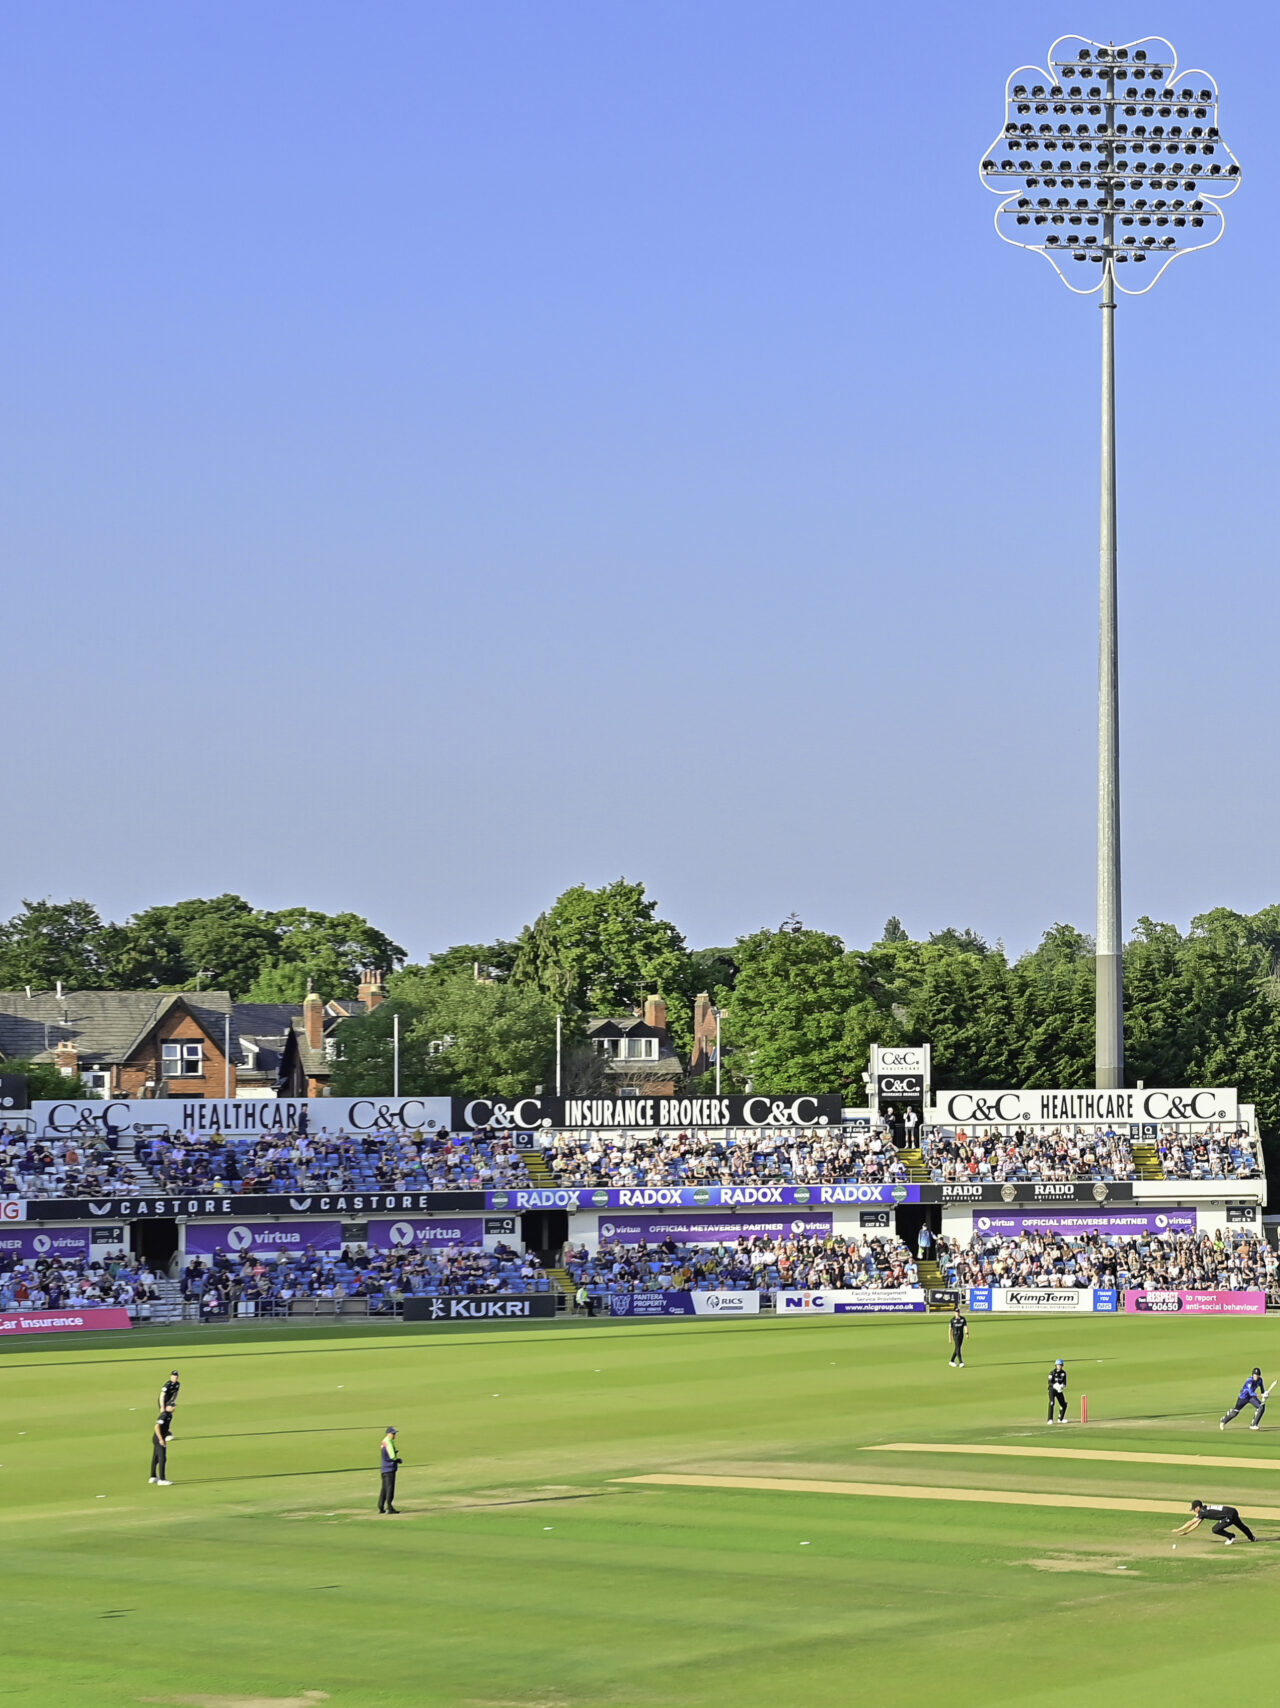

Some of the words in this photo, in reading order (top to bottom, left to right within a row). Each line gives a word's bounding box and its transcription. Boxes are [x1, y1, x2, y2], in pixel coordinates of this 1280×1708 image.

[1041, 1094, 1134, 1119] HEALTHCARE
[564, 1099, 654, 1127] INSURANCE
[659, 1098, 731, 1126] BROKERS
[1144, 1126, 1153, 1135] Q
[820, 1186, 883, 1203] RADOX
[942, 1185, 982, 1196] RADO
[1034, 1184, 1075, 1195] RADO
[516, 1190, 580, 1209] RADOX
[619, 1189, 683, 1206] RADOX
[720, 1187, 783, 1205] RADOX
[120, 1200, 232, 1214] CASTORE
[320, 1196, 428, 1210] CASTORE
[878, 1214, 887, 1222] Q
[1244, 1209, 1253, 1218] Q
[503, 1220, 512, 1229] Q
[991, 1219, 1015, 1227] virtua
[1022, 1219, 1059, 1227] OFFICIAL
[1060, 1218, 1108, 1226] METAVERSE
[1109, 1217, 1148, 1225] PARTNER
[1168, 1217, 1192, 1225] virtua
[615, 1224, 641, 1233] virtua
[648, 1224, 689, 1233] OFFICIAL
[690, 1223, 742, 1233] METAVERSE
[743, 1223, 784, 1231] PARTNER
[805, 1222, 831, 1231] virtua
[113, 1229, 120, 1238] P
[254, 1230, 301, 1243] virtua
[416, 1227, 461, 1240] virtua
[52, 1238, 85, 1248] virtua
[1009, 1292, 1075, 1305] KrimpTerm
[1146, 1291, 1179, 1303] RESPECT
[1194, 1295, 1217, 1303] report
[450, 1299, 530, 1317] KUKRI
[844, 1303, 914, 1312] www.nicgroup.co.uk
[1151, 1302, 1178, 1311] 60650
[1185, 1302, 1222, 1311] anti-social
[1223, 1303, 1259, 1312] behaviour
[20, 1316, 84, 1328] insurance
